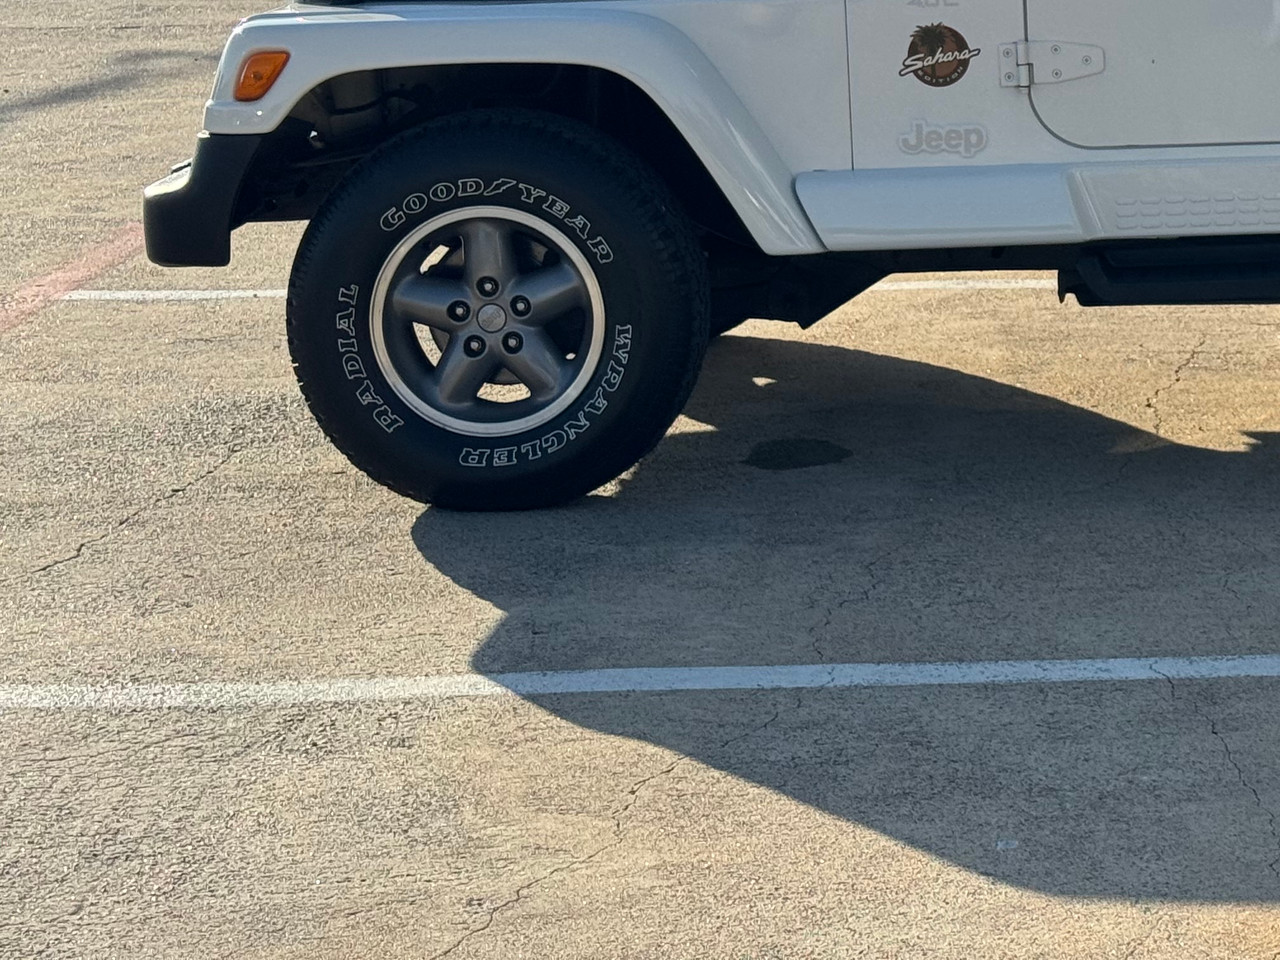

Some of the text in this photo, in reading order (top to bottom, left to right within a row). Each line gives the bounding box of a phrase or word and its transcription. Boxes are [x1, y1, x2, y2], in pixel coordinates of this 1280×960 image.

[901, 47, 979, 76] Sahara
[918, 66, 963, 84] EDITION
[901, 122, 986, 154] Jeep
[337, 284, 404, 433] RADIAL
[459, 324, 632, 467] WRANGLER
